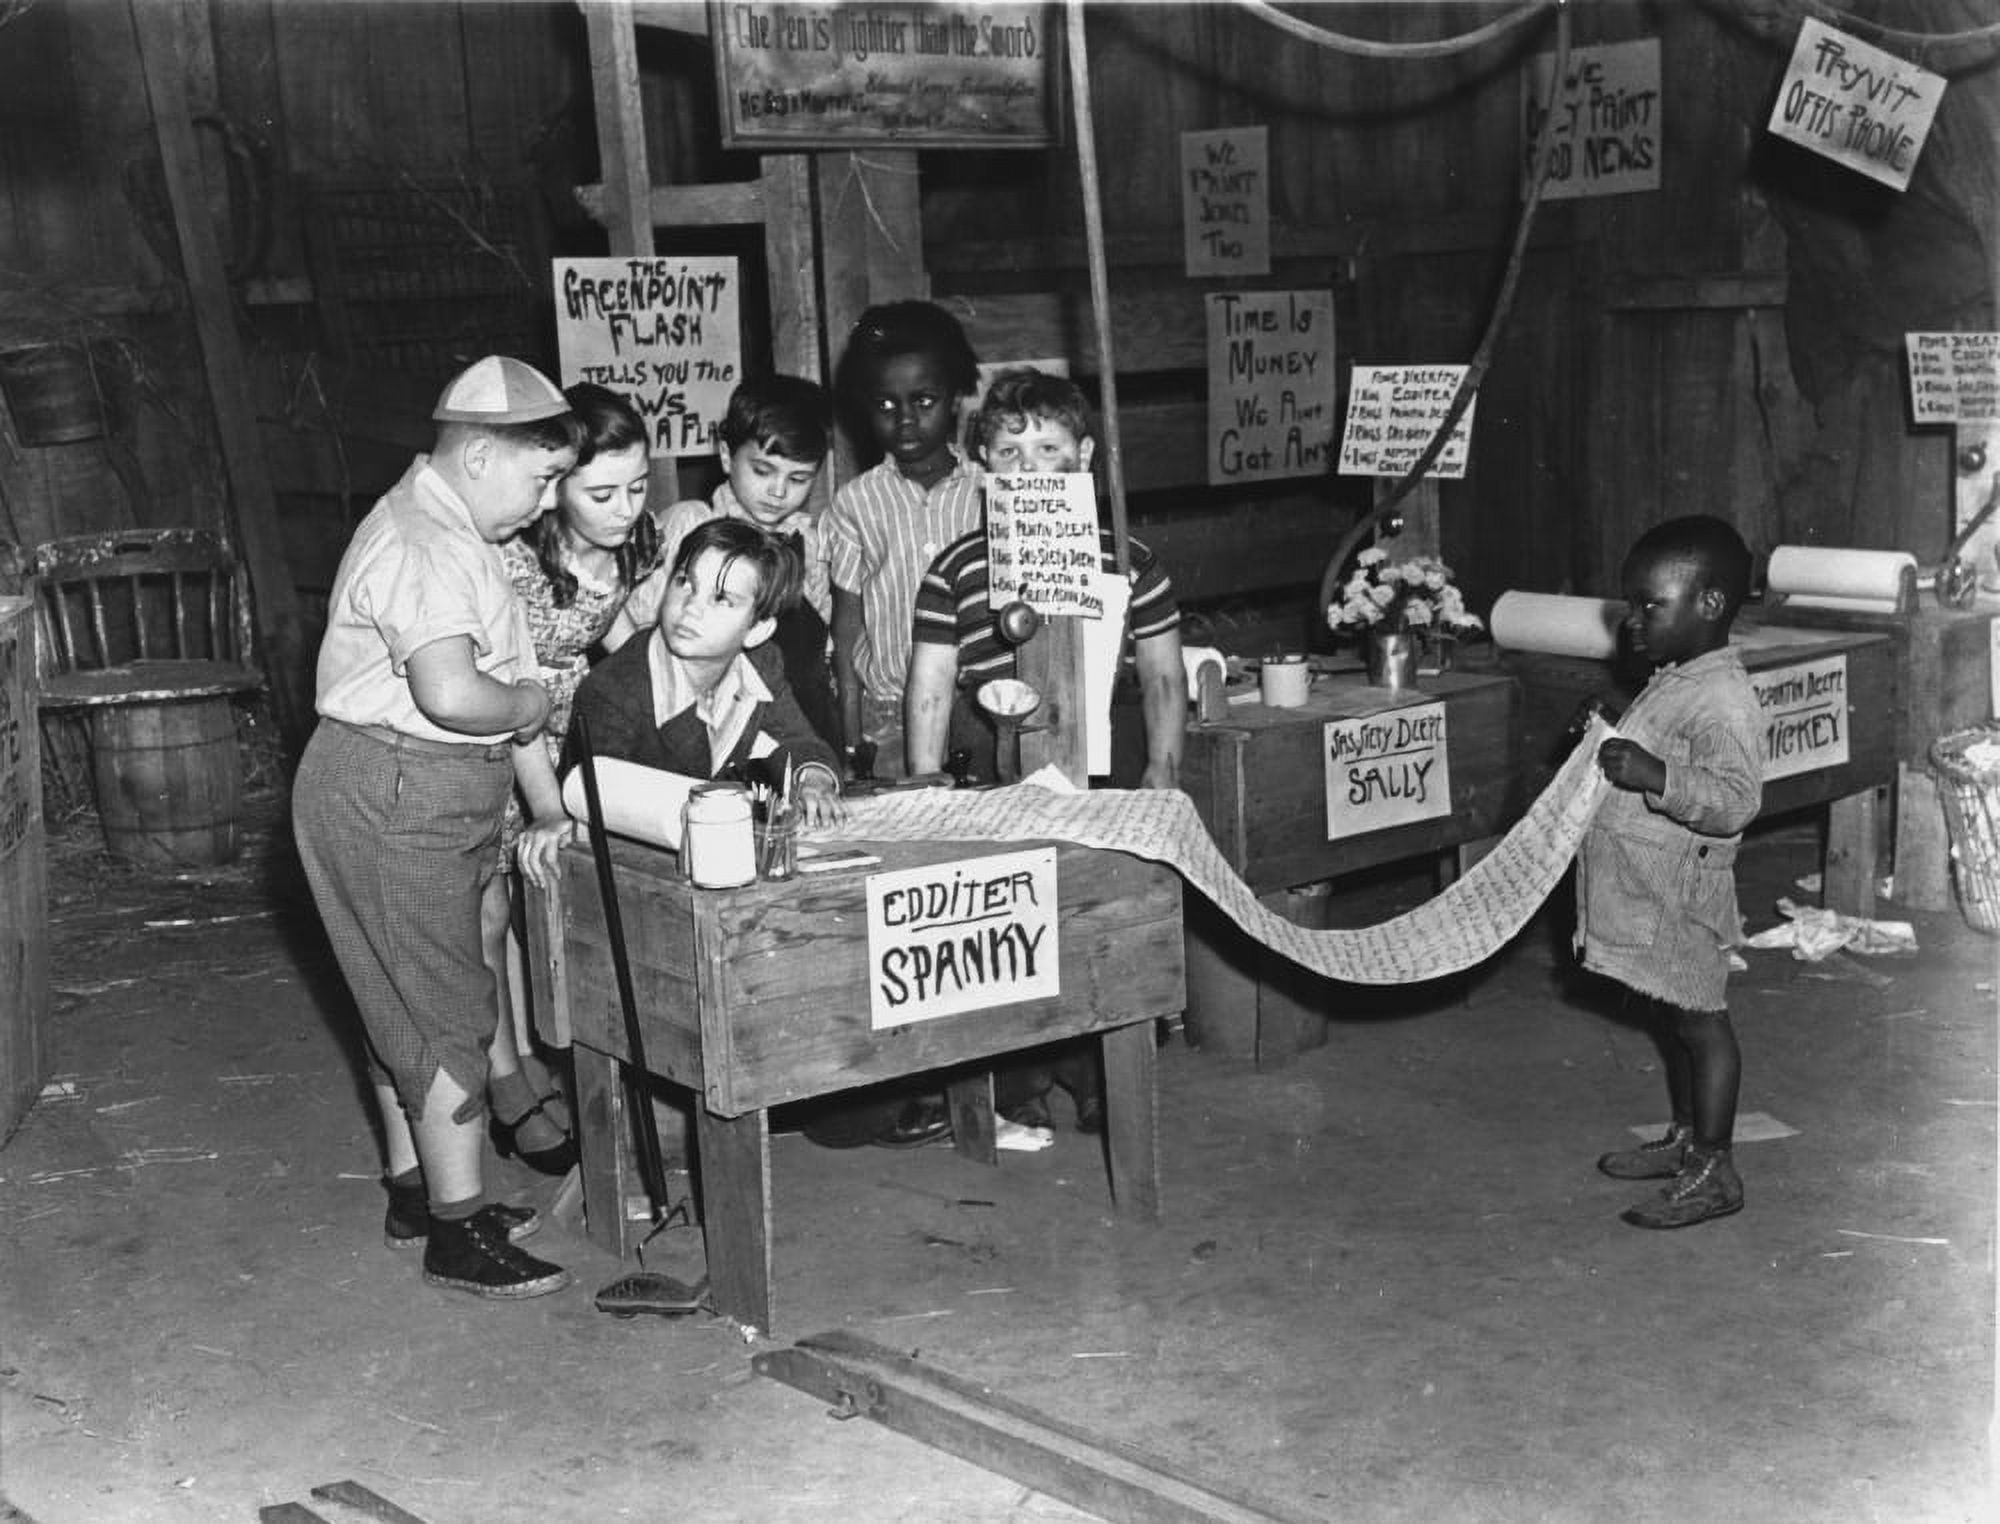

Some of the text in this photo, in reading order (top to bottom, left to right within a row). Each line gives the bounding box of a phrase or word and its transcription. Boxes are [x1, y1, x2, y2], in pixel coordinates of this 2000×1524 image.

[626, 260, 667, 277] THE
[608, 313, 703, 356] FLASH
[580, 361, 648, 386] TELLS
[653, 359, 689, 386] YOU
[1348, 757, 1435, 805] SALLY
[881, 922, 1046, 1008] SPANKY
